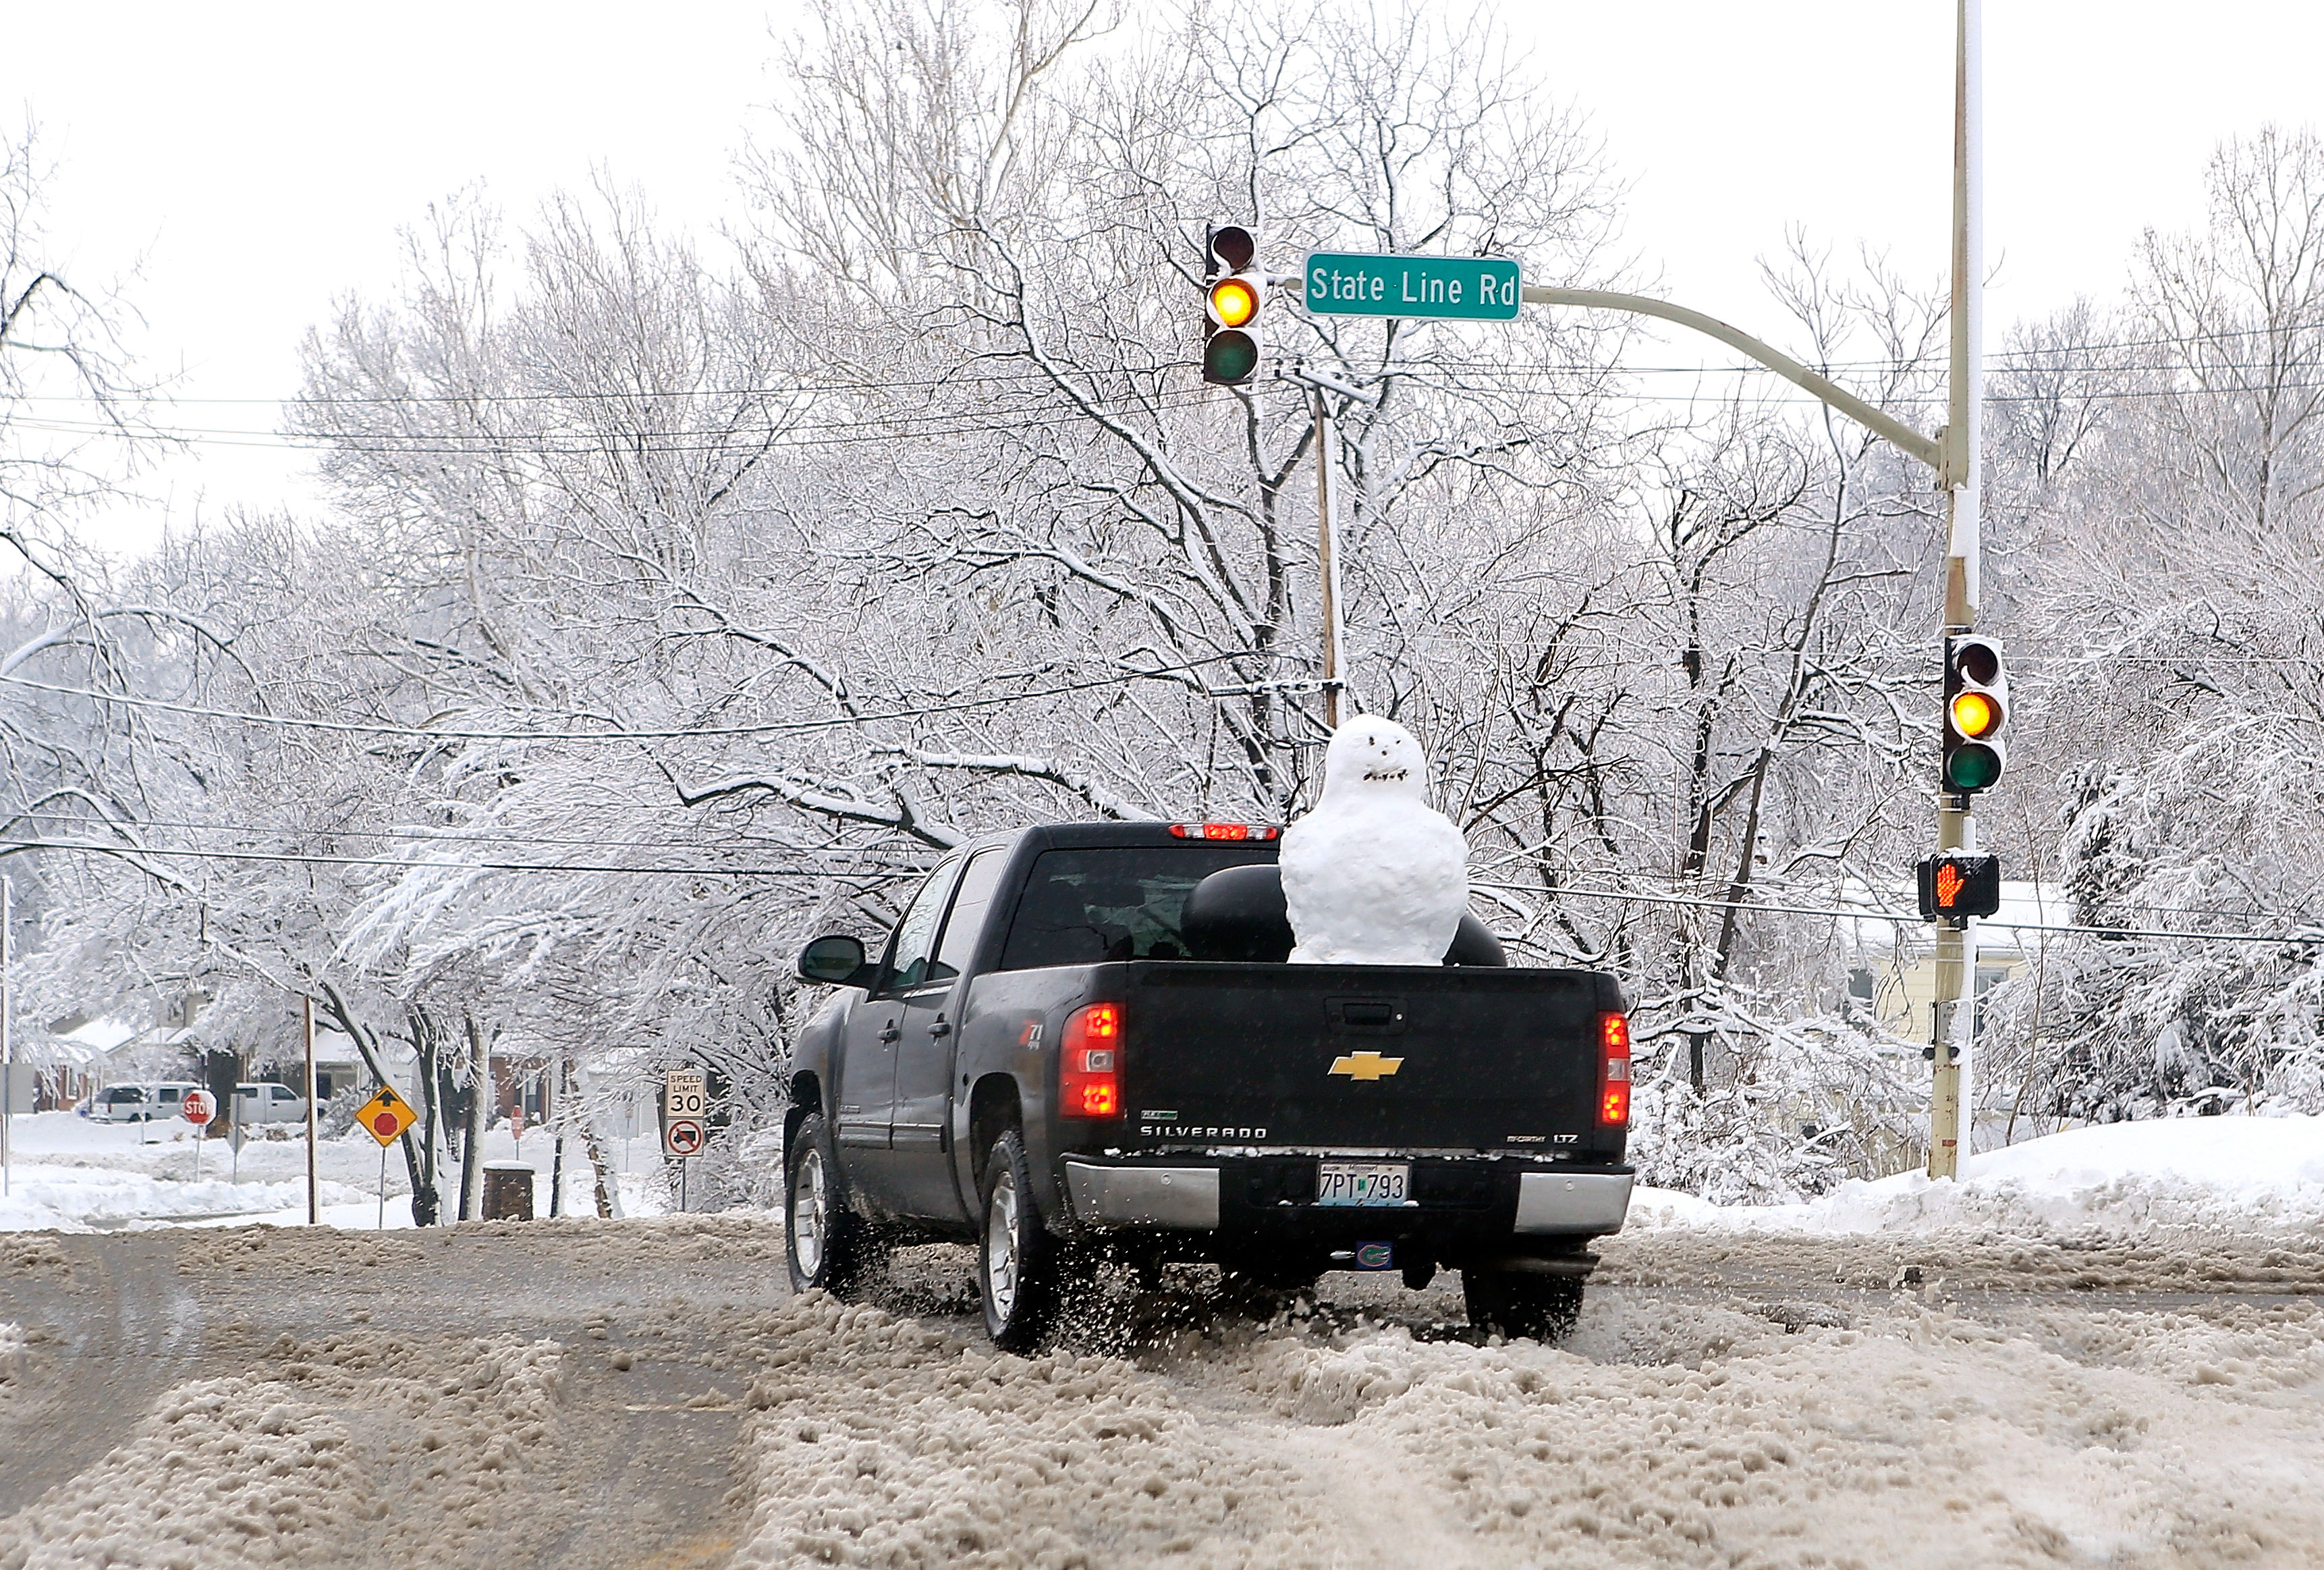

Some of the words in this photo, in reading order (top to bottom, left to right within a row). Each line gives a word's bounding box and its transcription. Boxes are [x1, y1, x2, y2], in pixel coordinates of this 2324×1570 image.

[1311, 268, 1384, 301] State
[1402, 271, 1462, 304] Line
[1480, 274, 1515, 306] Rd
[670, 1075, 702, 1083] SPEED
[670, 1095, 700, 1112] 30
[1140, 1126, 1267, 1139] SILVERADO
[1553, 1135, 1578, 1143] LTZ
[1321, 1173, 1357, 1198] 7PT
[1367, 1174, 1403, 1199] 793
